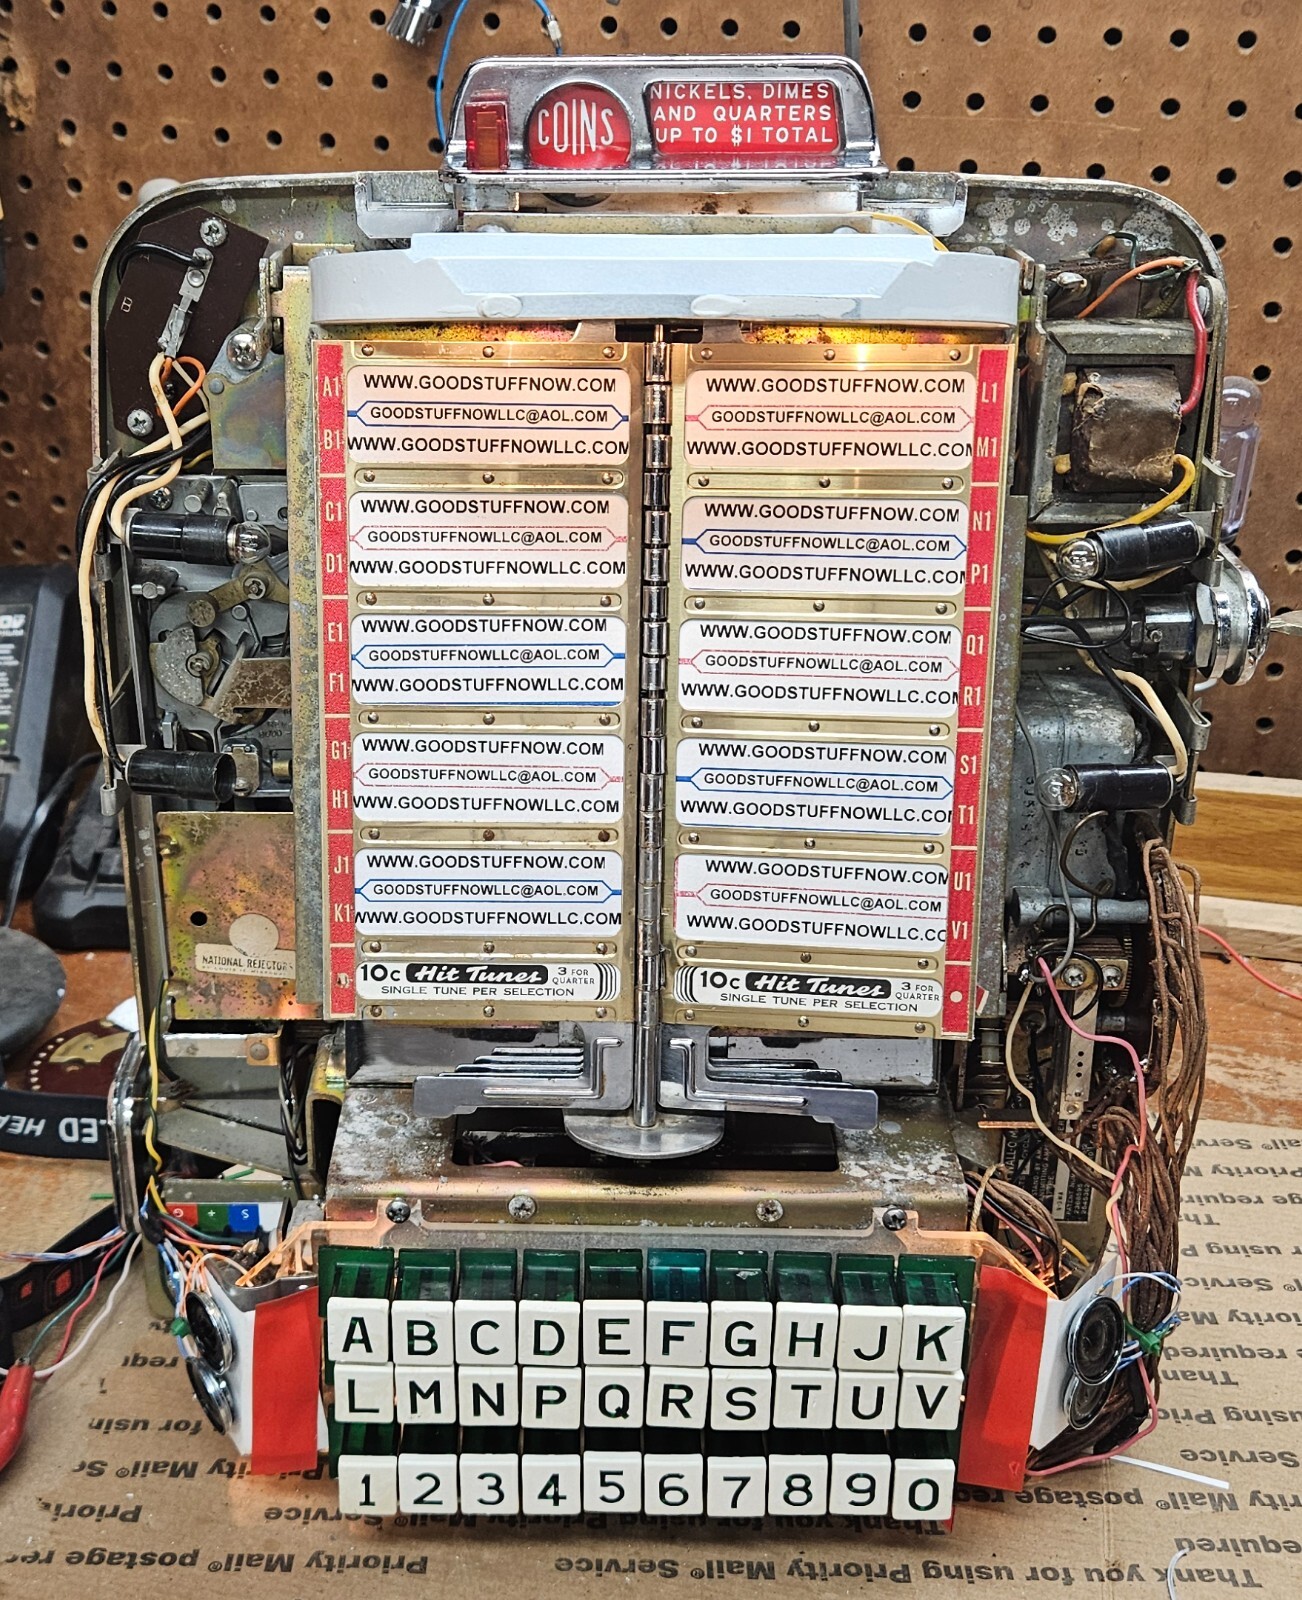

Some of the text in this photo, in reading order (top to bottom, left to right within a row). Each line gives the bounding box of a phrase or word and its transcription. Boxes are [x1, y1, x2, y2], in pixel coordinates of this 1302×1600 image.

[763, 83, 830, 100] DIMES
[654, 105, 831, 123] AND QUARTERS
[538, 98, 614, 156] COINS
[655, 124, 832, 146] UP TO $1 TOTAL
[323, 380, 341, 397] A1
[364, 374, 615, 391] WWW.GOODSTUFFNOW.COM
[707, 379, 964, 392] WWW.GOODSTUFFNOW.COM
[981, 383, 998, 402] L1
[371, 407, 607, 424] GOODSTUFFNOWLLC@AOL.COM
[712, 411, 955, 426] GOODSTUFFNOWLLC@AOL.COM
[324, 430, 343, 448] B1
[348, 437, 628, 454] WWW.GOODSTUFFNOWLLC.COM
[977, 436, 998, 457] M1
[325, 502, 342, 521] C1
[361, 500, 609, 513] WWW.GOODSTUFFNOW.COM
[705, 504, 959, 521] WWW.GOODSTUFFNOW.COM
[973, 511, 991, 531] N1
[368, 531, 601, 545] GOODSTUFFNOWLLC@AOL.COM
[710, 535, 949, 553] GOODSTUFFNOWLLC@AOL.COM
[326, 555, 343, 573] D1
[971, 564, 989, 584] P1
[328, 624, 344, 642] E1
[362, 619, 606, 632] WWW.GOODSTUFFNOW.COM
[701, 625, 951, 643] WWW.GOODSTUFFNOW.COM
[966, 635, 984, 655] Q1
[370, 650, 599, 663] GOODSTUFFNOWLLC@AOL.COM
[706, 655, 941, 673] GOODSTUFFNOWLLC@AOL.COM
[329, 672, 344, 692] F1
[964, 686, 981, 705] R1
[331, 741, 348, 759] G1
[362, 739, 603, 755] WWW.GOODSTUFFNOW.COM
[699, 743, 947, 764] WWW.GOODSTUFFNOW.COM
[960, 754, 977, 775] S1
[369, 768, 595, 784] GOODSTUFFNOWLLC@AOL.COM
[704, 773, 938, 792] GOODSTUFFNOWLLC@AOL.COM
[332, 789, 348, 808] H1
[958, 805, 974, 825] T1
[334, 856, 349, 874] J1
[367, 856, 605, 868] WWW.GOODSTUFFNOW.COM
[706, 860, 948, 885] WWW.GOODSTUFFNOW.COM
[954, 872, 971, 892] U1
[374, 885, 597, 898] GOODSTUFFNOWLLC@AOL.COM
[711, 889, 941, 912] GOODSTUFFNOWLLC@AOL.COM
[334, 903, 351, 922] K1
[952, 920, 968, 940] V1
[202, 956, 243, 967] NATIONAL
[361, 964, 542, 984] 10c Hit Tunes
[558, 967, 566, 976] 3
[552, 977, 595, 986] QUARTER
[700, 970, 885, 997] 10c Hit Tunes
[901, 981, 911, 990] 3
[381, 986, 574, 997] SINGLE TUNE PER SELECTION
[895, 992, 940, 1001] QUARTER
[720, 993, 918, 1012] SINGLE TUNE PER SELECTION
[58, 1117, 106, 1143] ED
[1180, 1193, 1264, 1206] requir
[1206, 1242, 1282, 1258] using
[1182, 1278, 1274, 1292] Servic
[343, 1317, 953, 1361] A B C D E F G H J K
[1162, 1344, 1288, 1362] required
[1160, 1370, 1239, 1386] Than
[348, 1379, 948, 1420] L M N P Q R S T U V
[1223, 1406, 1302, 1425] using
[87, 1418, 204, 1435] for usin
[1180, 1450, 1300, 1468] Service
[360, 1475, 375, 1506] 1
[414, 1473, 442, 1504] 2
[478, 1473, 504, 1505] 3
[538, 1474, 566, 1506] 4
[600, 1471, 624, 1503] 5
[659, 1474, 688, 1506] 6
[723, 1477, 750, 1508] 7
[783, 1474, 812, 1506] 8
[846, 1473, 876, 1506] 9
[1014, 1488, 1144, 1508] postage
[65, 1548, 200, 1570] postage
[306, 1551, 428, 1574] Priority
[554, 1558, 680, 1579] Service
[787, 1558, 912, 1584] Priority
[922, 1560, 1015, 1584] using
[1026, 1566, 1074, 1586] for
[1084, 1563, 1146, 1584] you
[1152, 1568, 1263, 1588] Thank
